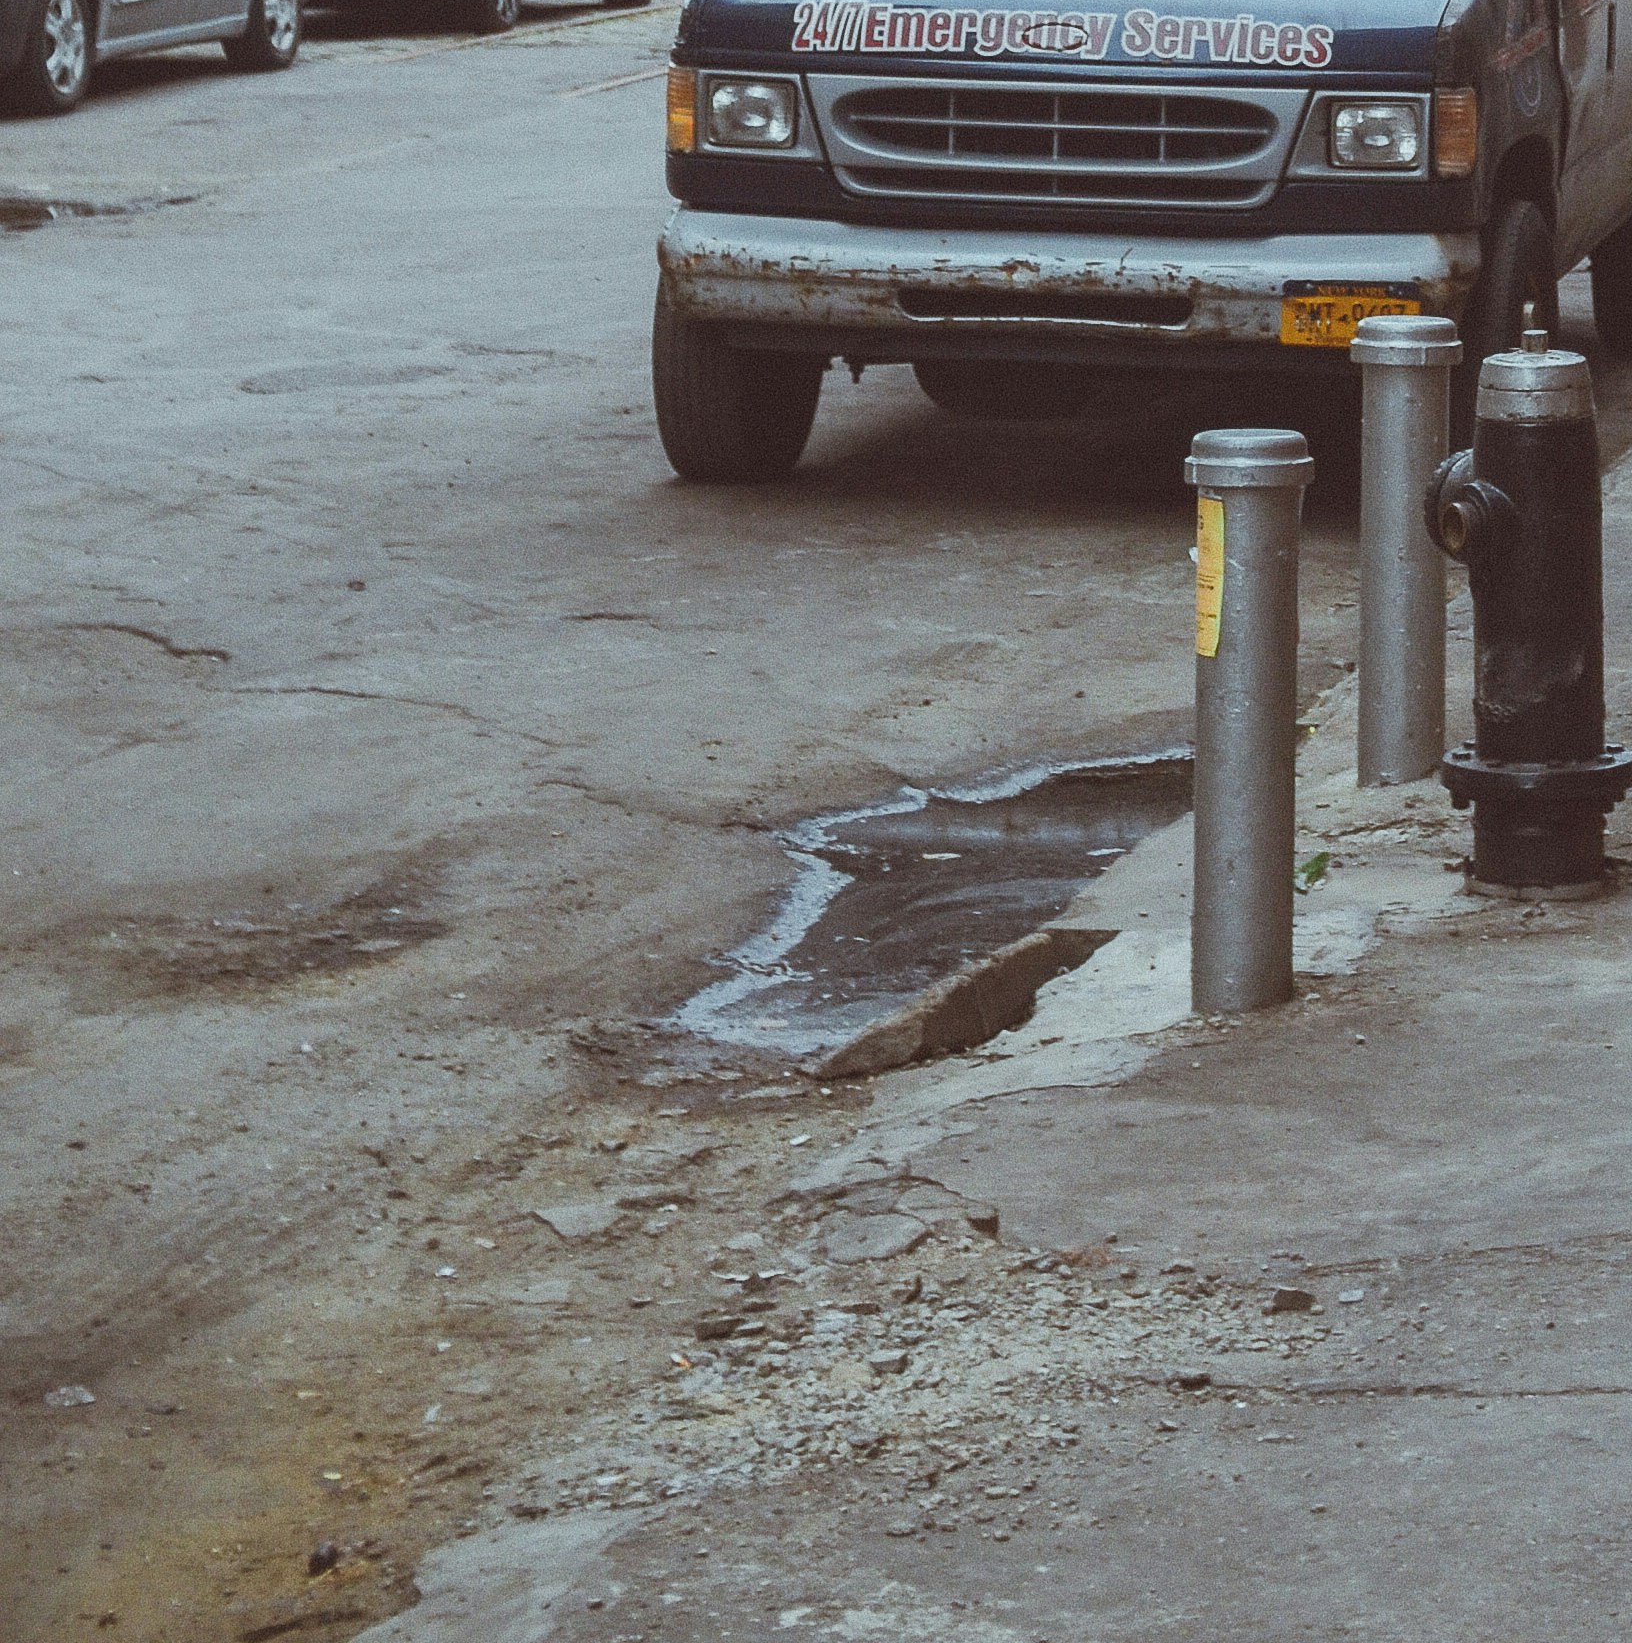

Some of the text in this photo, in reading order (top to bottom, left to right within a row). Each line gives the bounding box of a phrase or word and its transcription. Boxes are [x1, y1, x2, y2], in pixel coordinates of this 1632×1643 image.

[793, 0, 1333, 68] 24/7 Emergency Services
